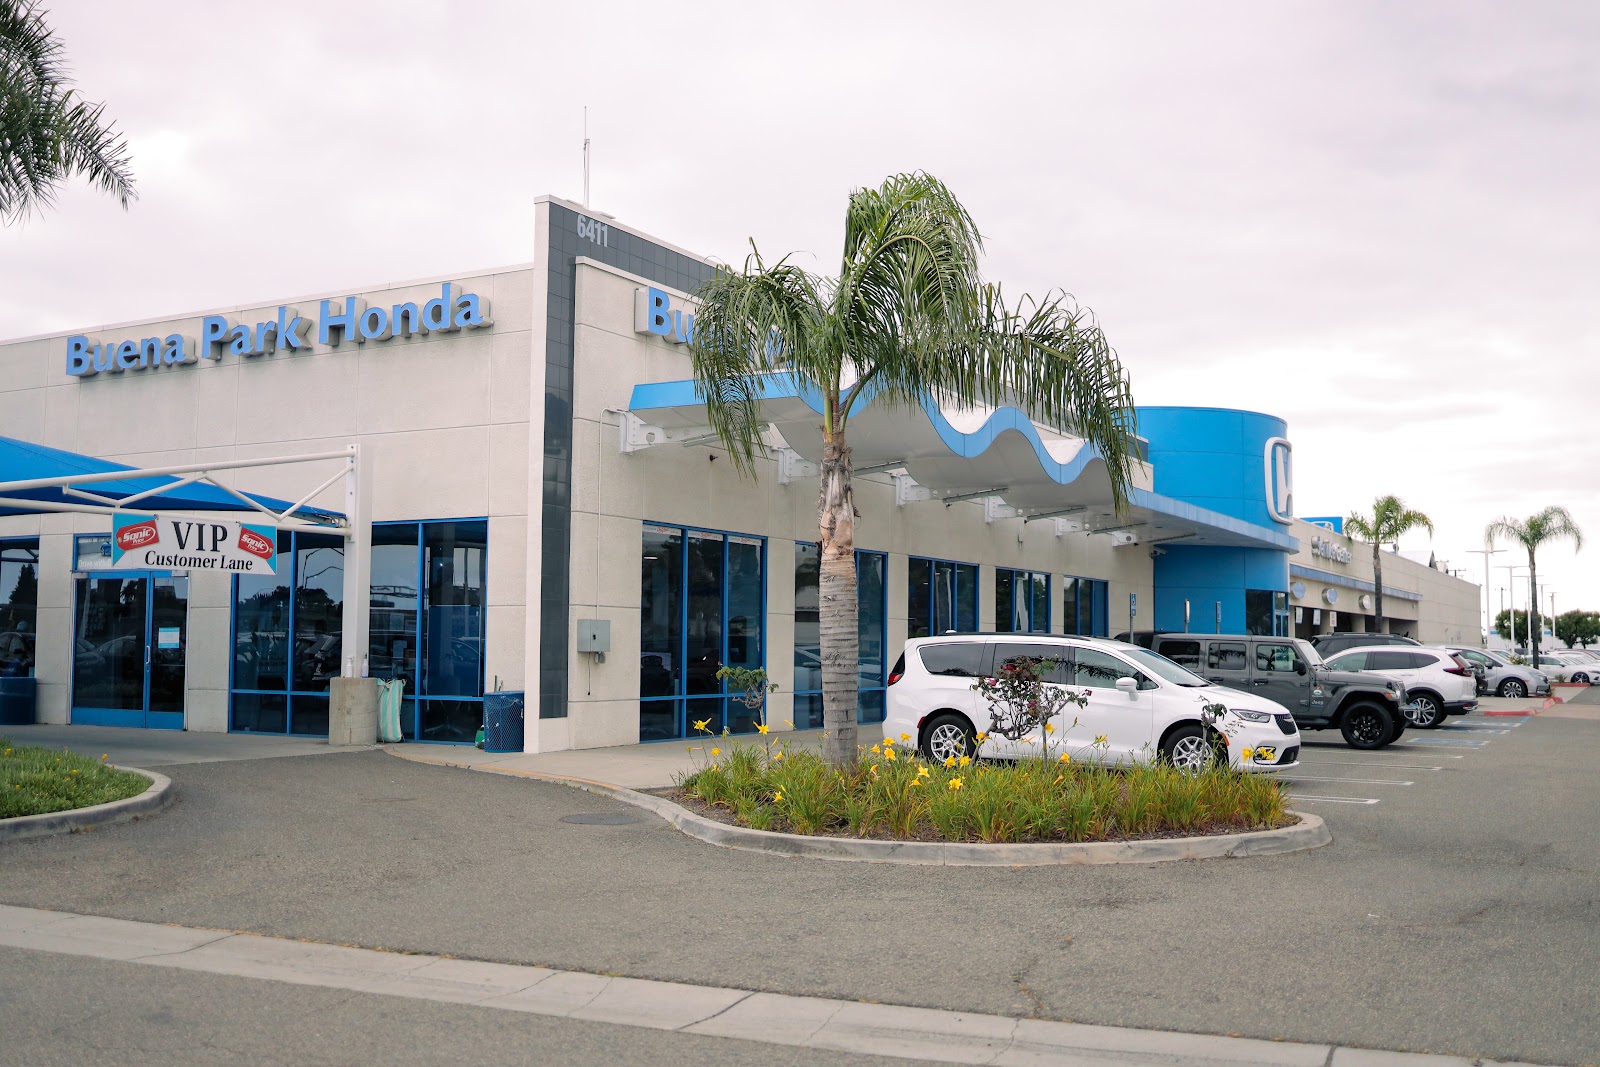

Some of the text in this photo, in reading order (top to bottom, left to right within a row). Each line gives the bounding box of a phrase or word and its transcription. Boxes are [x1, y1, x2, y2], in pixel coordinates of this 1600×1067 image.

[577, 214, 608, 248] 6411
[66, 281, 486, 376] Buena Park Honda
[123, 528, 151, 543] Sonic
[171, 521, 228, 553] VIP
[241, 533, 265, 550] Sonic
[145, 550, 253, 571] Customer Lane
